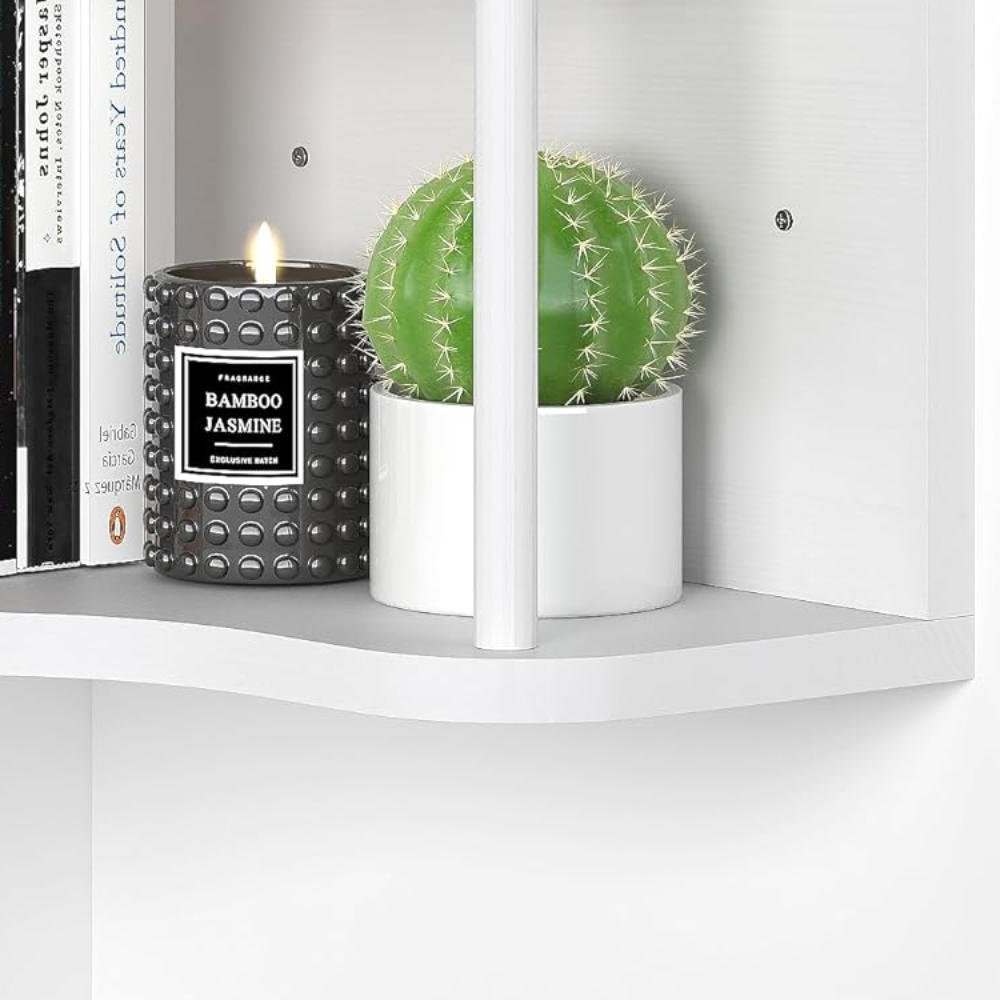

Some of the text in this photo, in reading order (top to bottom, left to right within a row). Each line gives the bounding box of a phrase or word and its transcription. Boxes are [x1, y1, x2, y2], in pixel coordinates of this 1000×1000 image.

[217, 374, 271, 383] FRAGRANCE
[205, 391, 283, 409] BAMBOO
[204, 416, 283, 434] JASMINE
[209, 454, 252, 464] EXCLUSIVE
